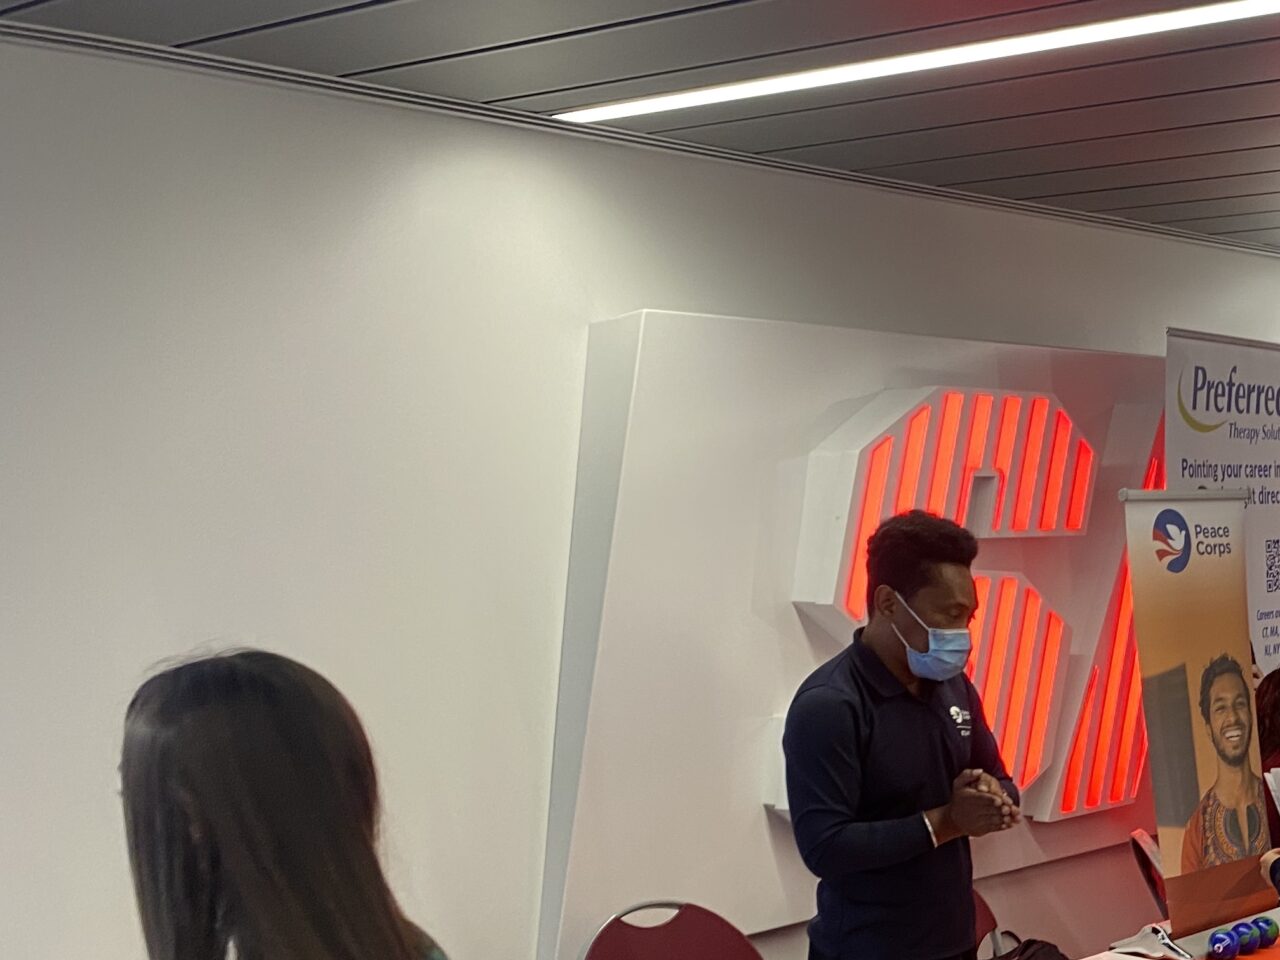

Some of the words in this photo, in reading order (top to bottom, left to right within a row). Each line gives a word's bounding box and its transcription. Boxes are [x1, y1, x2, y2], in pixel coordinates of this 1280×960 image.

[1229, 421, 1259, 445] Therapy
[1181, 458, 1218, 482] Pointing
[1220, 463, 1242, 482] your
[1244, 463, 1272, 478] career
[1274, 460, 1280, 478] in
[1194, 524, 1230, 540] Peace
[1196, 540, 1232, 558] Corps
[1256, 609, 1274, 621] Careers
[1270, 625, 1279, 637] MA,
[1273, 642, 1280, 655] NY
